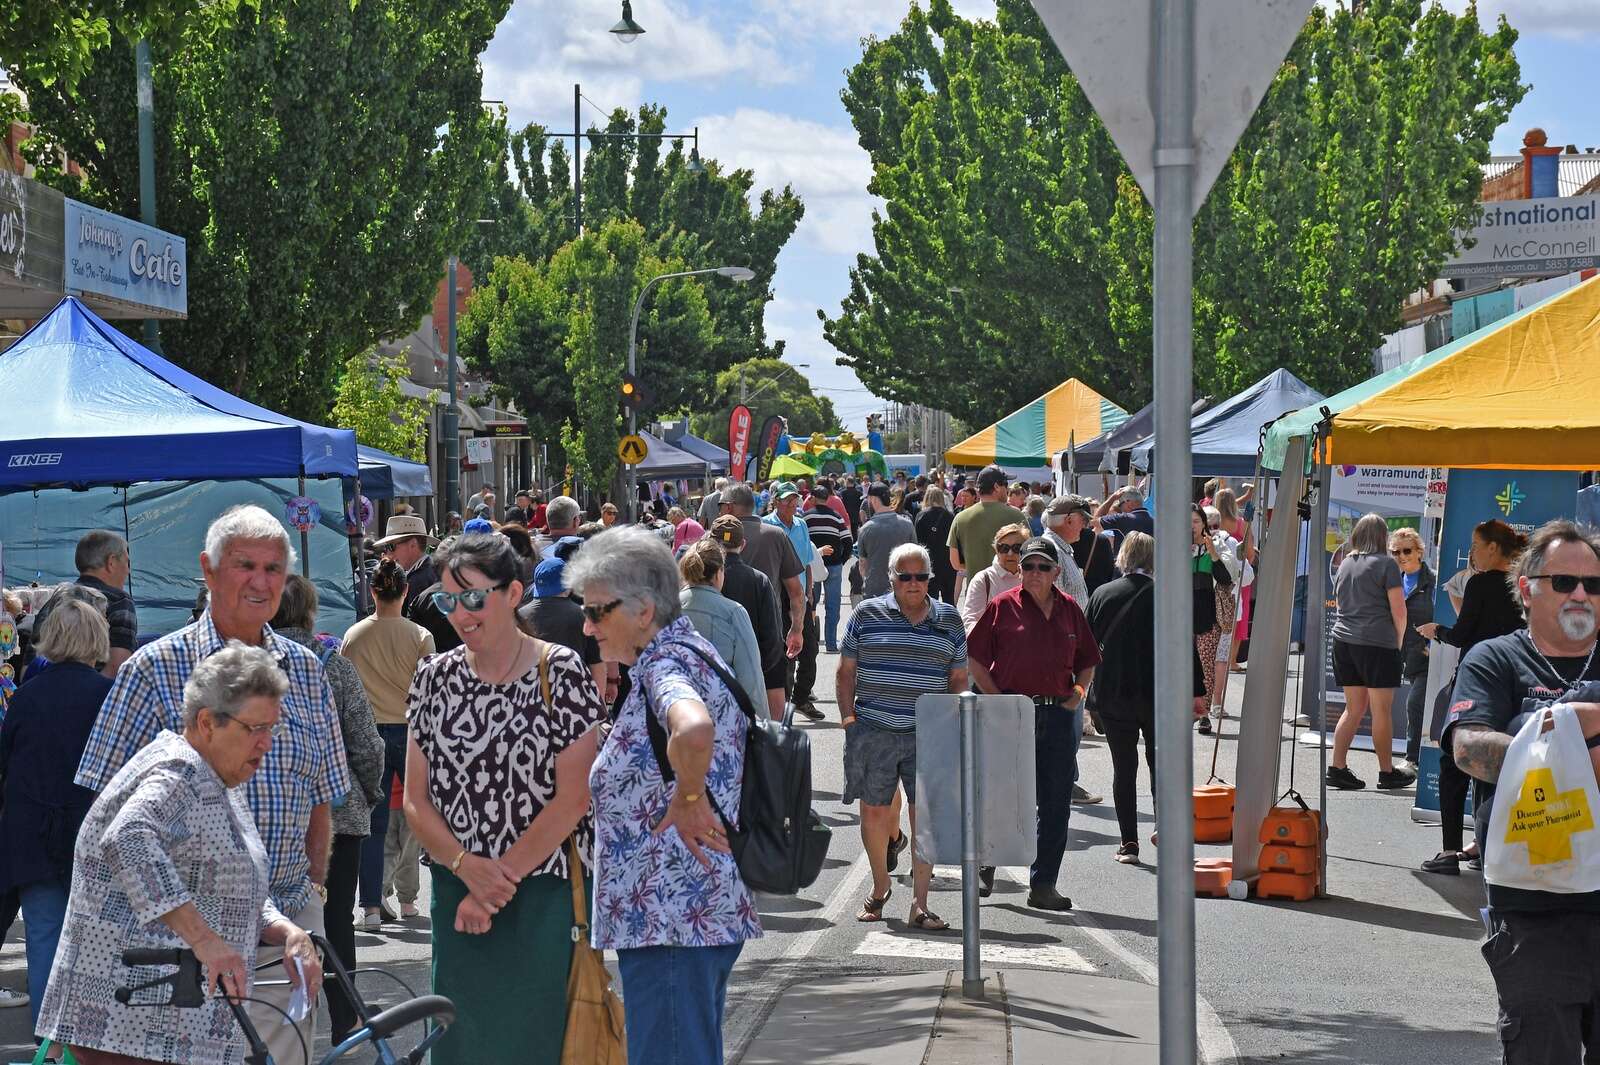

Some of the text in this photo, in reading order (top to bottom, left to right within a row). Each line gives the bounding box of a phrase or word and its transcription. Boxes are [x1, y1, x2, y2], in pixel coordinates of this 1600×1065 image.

[1492, 236, 1596, 259] McConnell
[733, 415, 748, 466] SALE
[8, 452, 63, 467] KINGS
